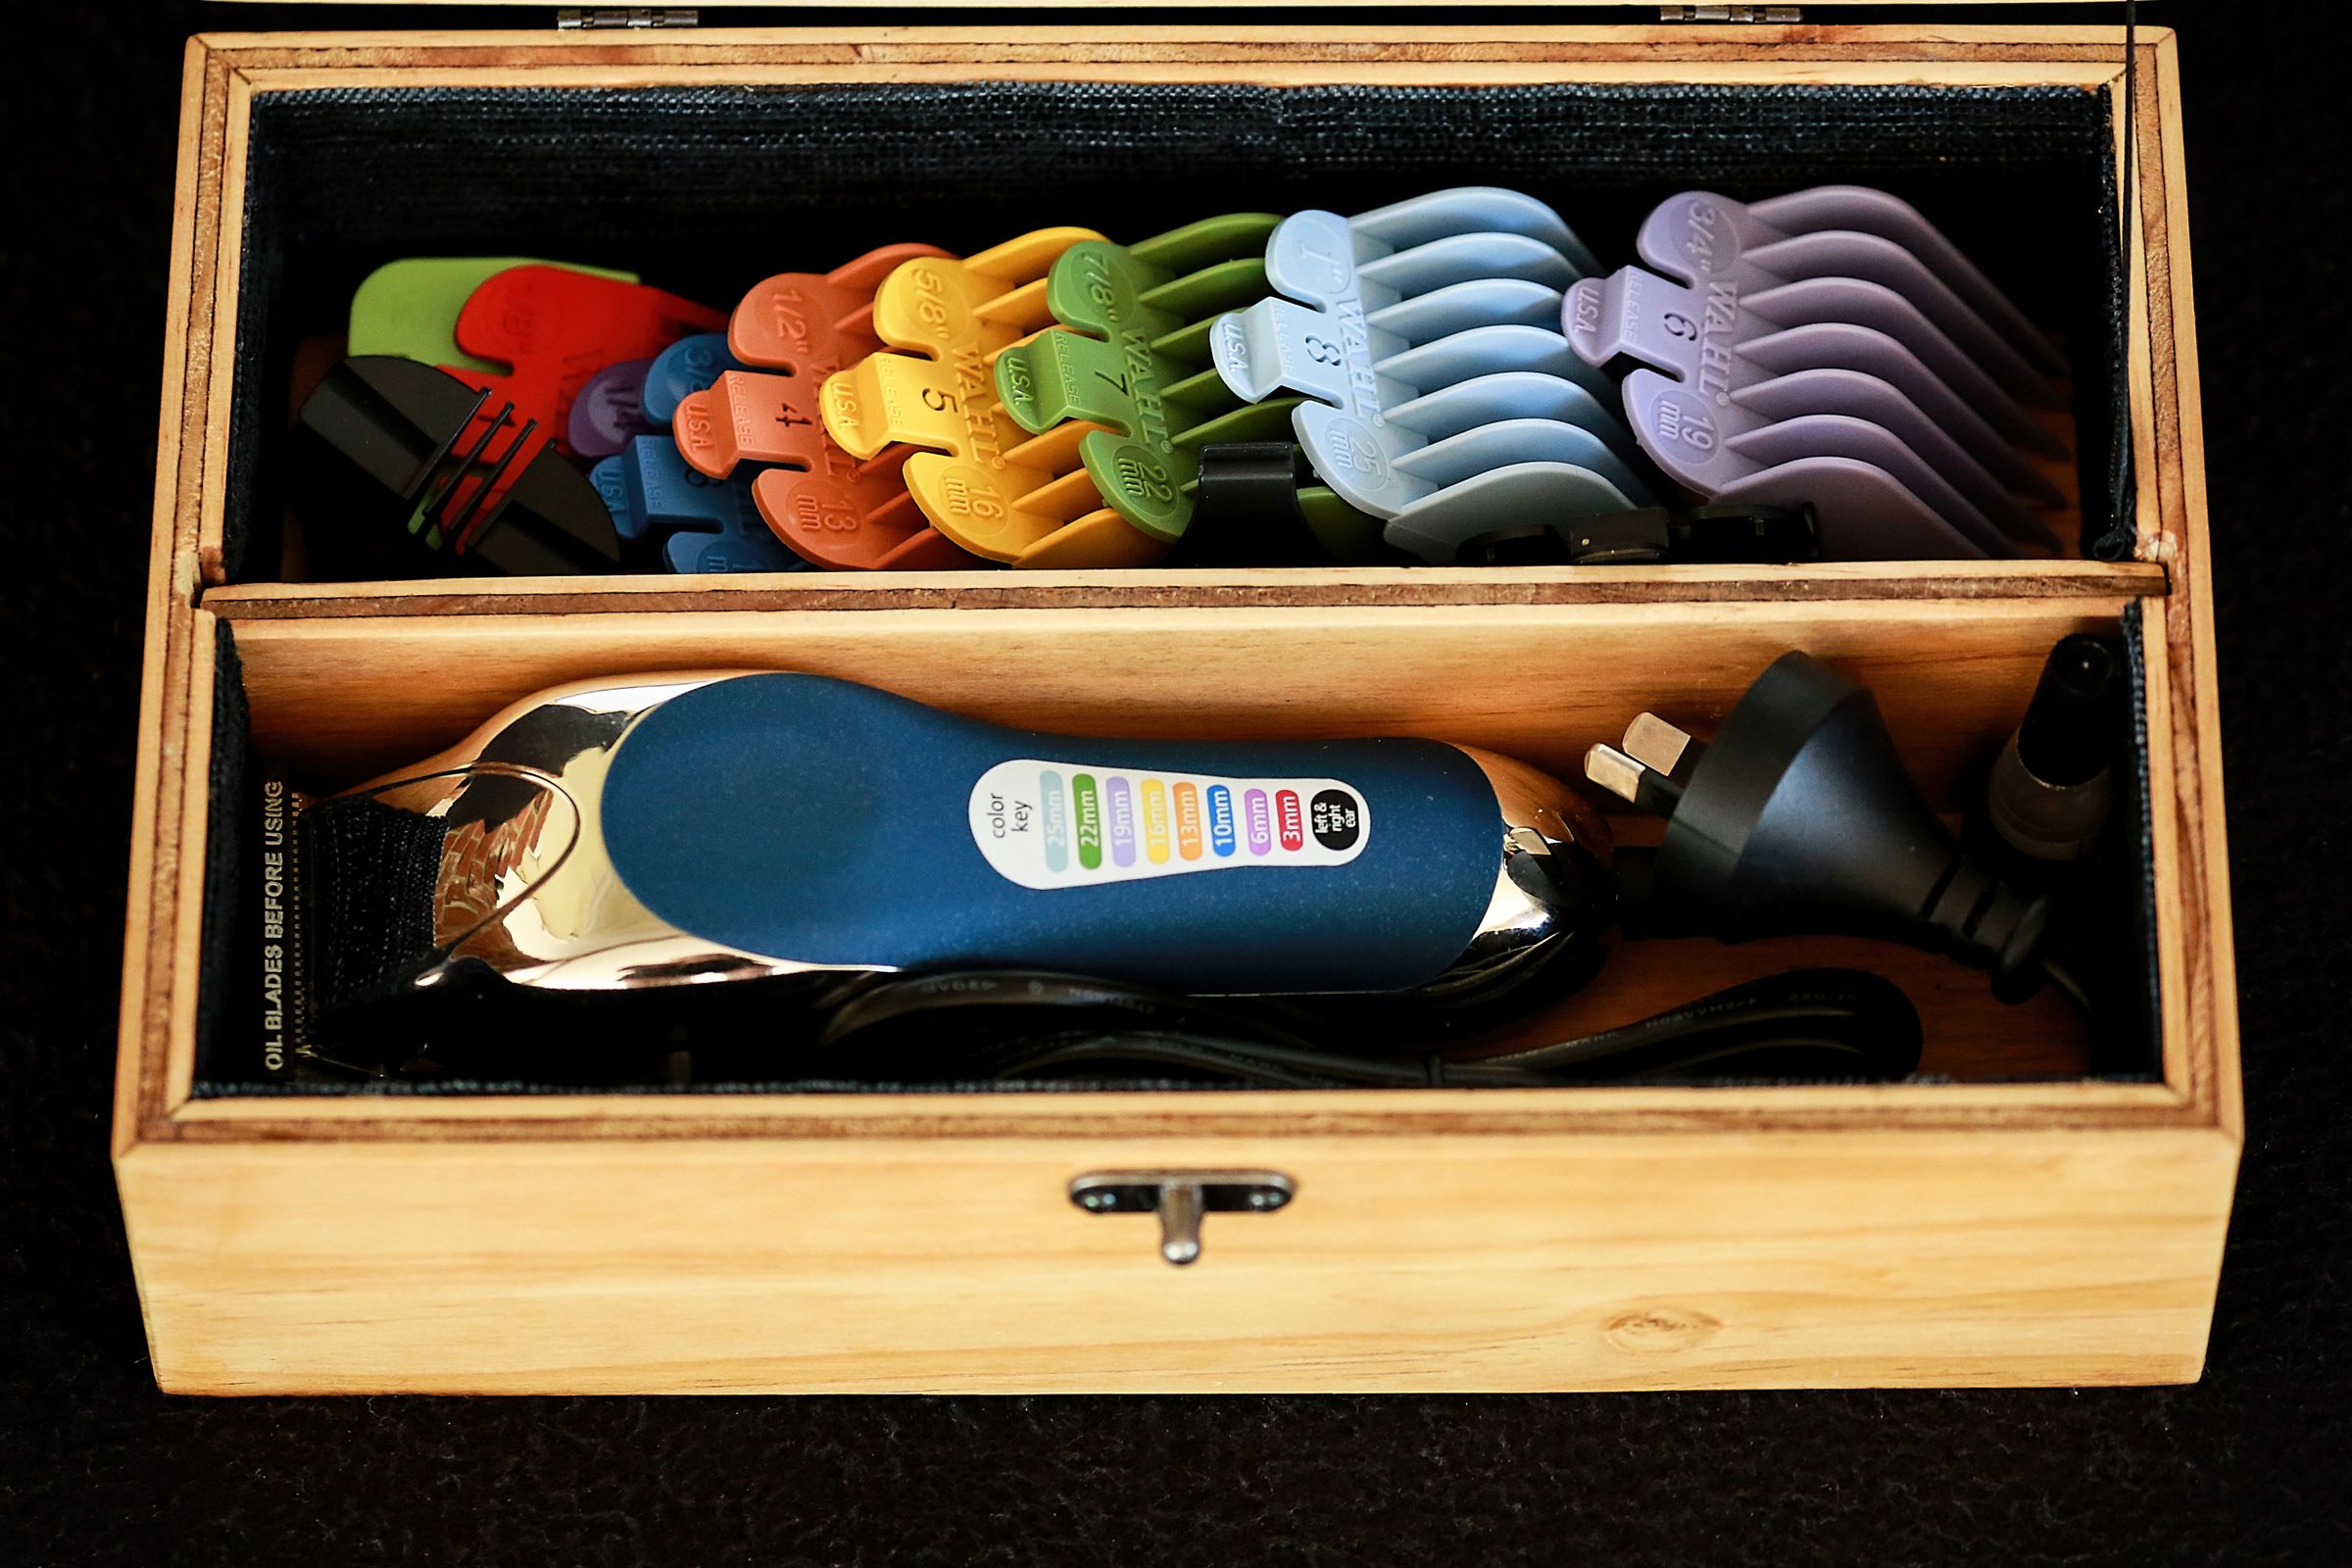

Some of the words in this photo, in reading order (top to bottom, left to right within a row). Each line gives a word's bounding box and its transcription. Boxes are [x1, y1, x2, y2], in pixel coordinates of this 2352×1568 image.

[913, 269, 951, 339] 5/8"
[1080, 252, 1119, 323] 7/8"
[1623, 268, 1643, 342] RELEASE
[771, 288, 811, 354] 1/2"
[1274, 300, 1298, 373] RELEASE
[1664, 312, 1698, 342] 6
[1054, 332, 1082, 405] RELEASE
[1222, 322, 1249, 373] U.S.A.
[1304, 334, 1342, 367] 8
[877, 354, 905, 428] RELEASE
[921, 388, 959, 414] 5
[1006, 356, 1033, 405] U.S.A.
[1094, 369, 1130, 396] 7
[686, 403, 712, 452] U.S.A.
[727, 373, 754, 445] RELEASE
[775, 403, 812, 428] 4
[1658, 400, 1680, 441] mm
[1330, 428, 1354, 469] mm
[1682, 415, 1715, 451] 19
[1115, 458, 1145, 496] mm
[1353, 436, 1383, 480] 25
[946, 477, 970, 515] mm
[975, 485, 1004, 520] 16
[1140, 464, 1173, 505] 22
[796, 494, 822, 532] mm
[821, 496, 858, 532] 13
[265, 780, 284, 845] USING
[986, 793, 1005, 839] color
[1011, 800, 1033, 832] key
[1047, 790, 1065, 848] 25mm
[1080, 790, 1100, 848] 22mm
[1113, 790, 1133, 847] 19mm
[1149, 790, 1164, 847] 16mm
[1180, 791, 1199, 847] 13mm
[1212, 790, 1233, 847] 10mm
[1250, 797, 1269, 844] 6mm
[1283, 796, 1301, 842] 3mm
[1313, 802, 1327, 812] &
[1314, 813, 1329, 834] left
[1346, 808, 1356, 828] ear
[265, 852, 284, 939] BEFORE
[265, 945, 283, 1030] BLADES
[265, 1034, 283, 1070] OIL
